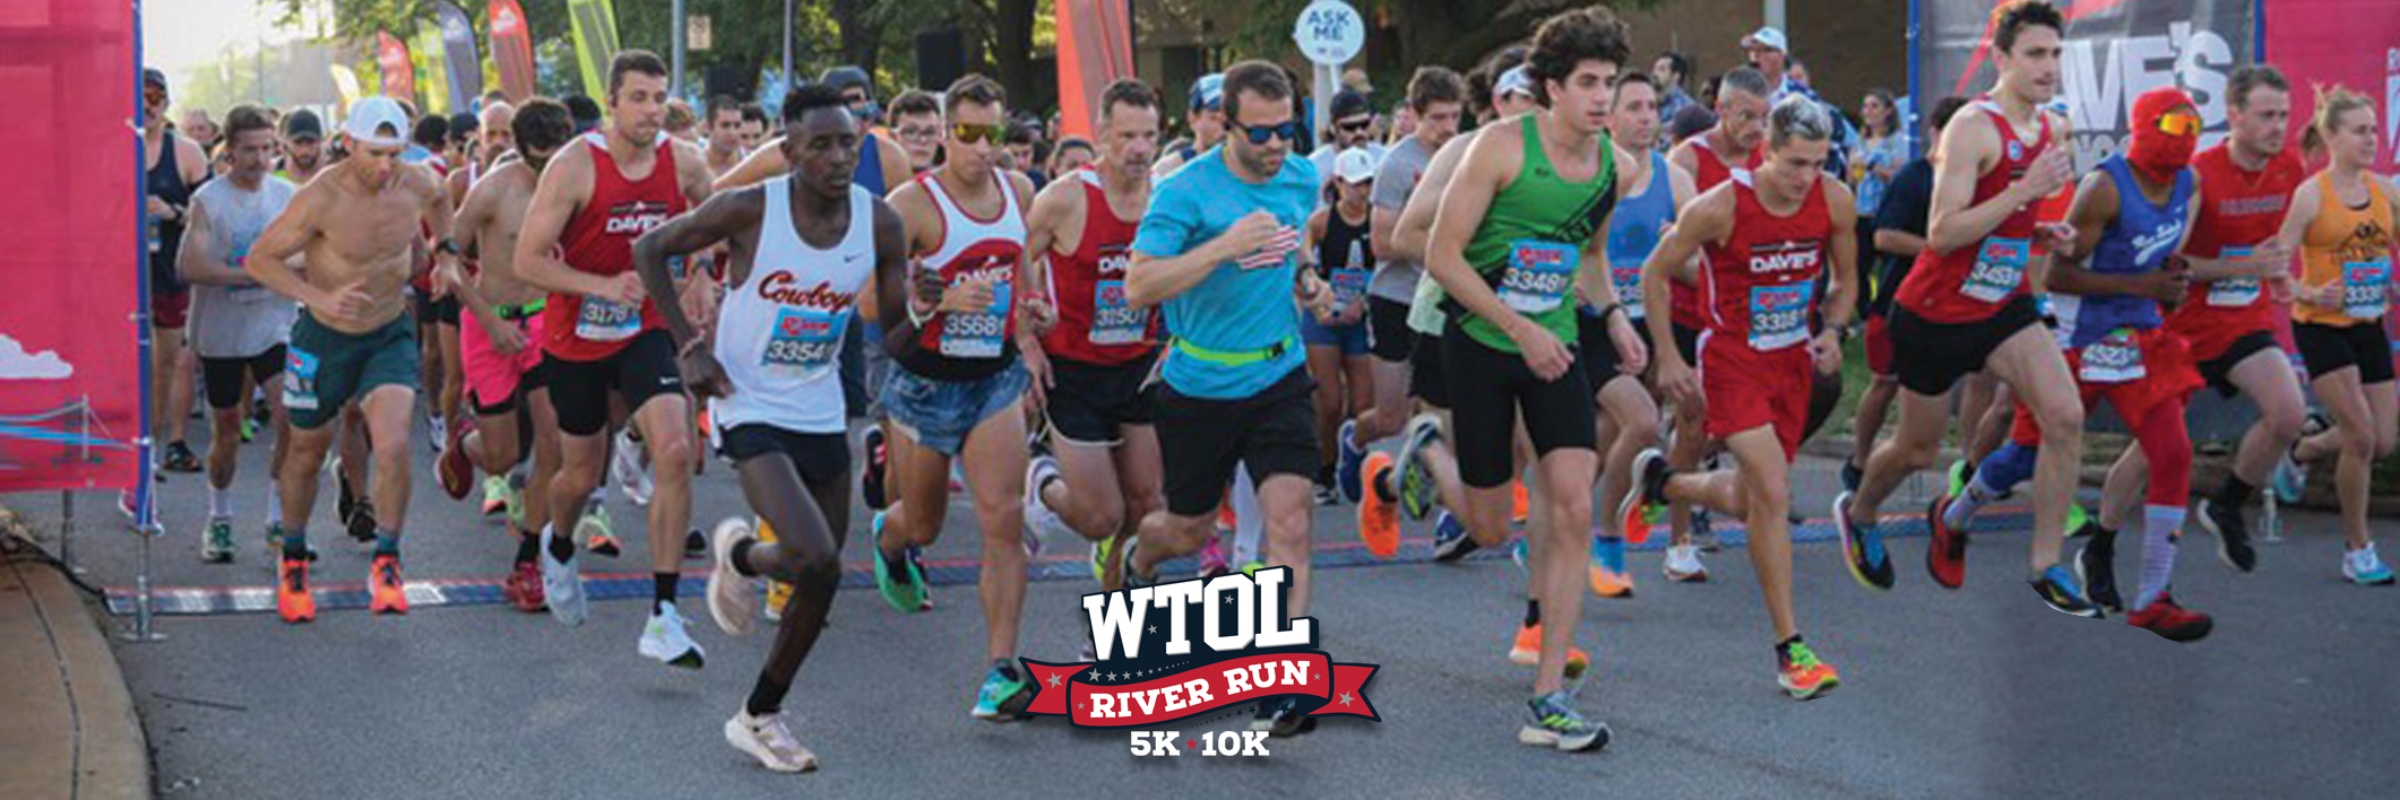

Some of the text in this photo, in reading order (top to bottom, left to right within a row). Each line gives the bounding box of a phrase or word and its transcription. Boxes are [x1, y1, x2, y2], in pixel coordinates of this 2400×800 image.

[1307, 9, 1350, 26] ASK
[1313, 26, 1343, 41] ME
[944, 314, 999, 336] 3568
[767, 340, 826, 361] 3354
